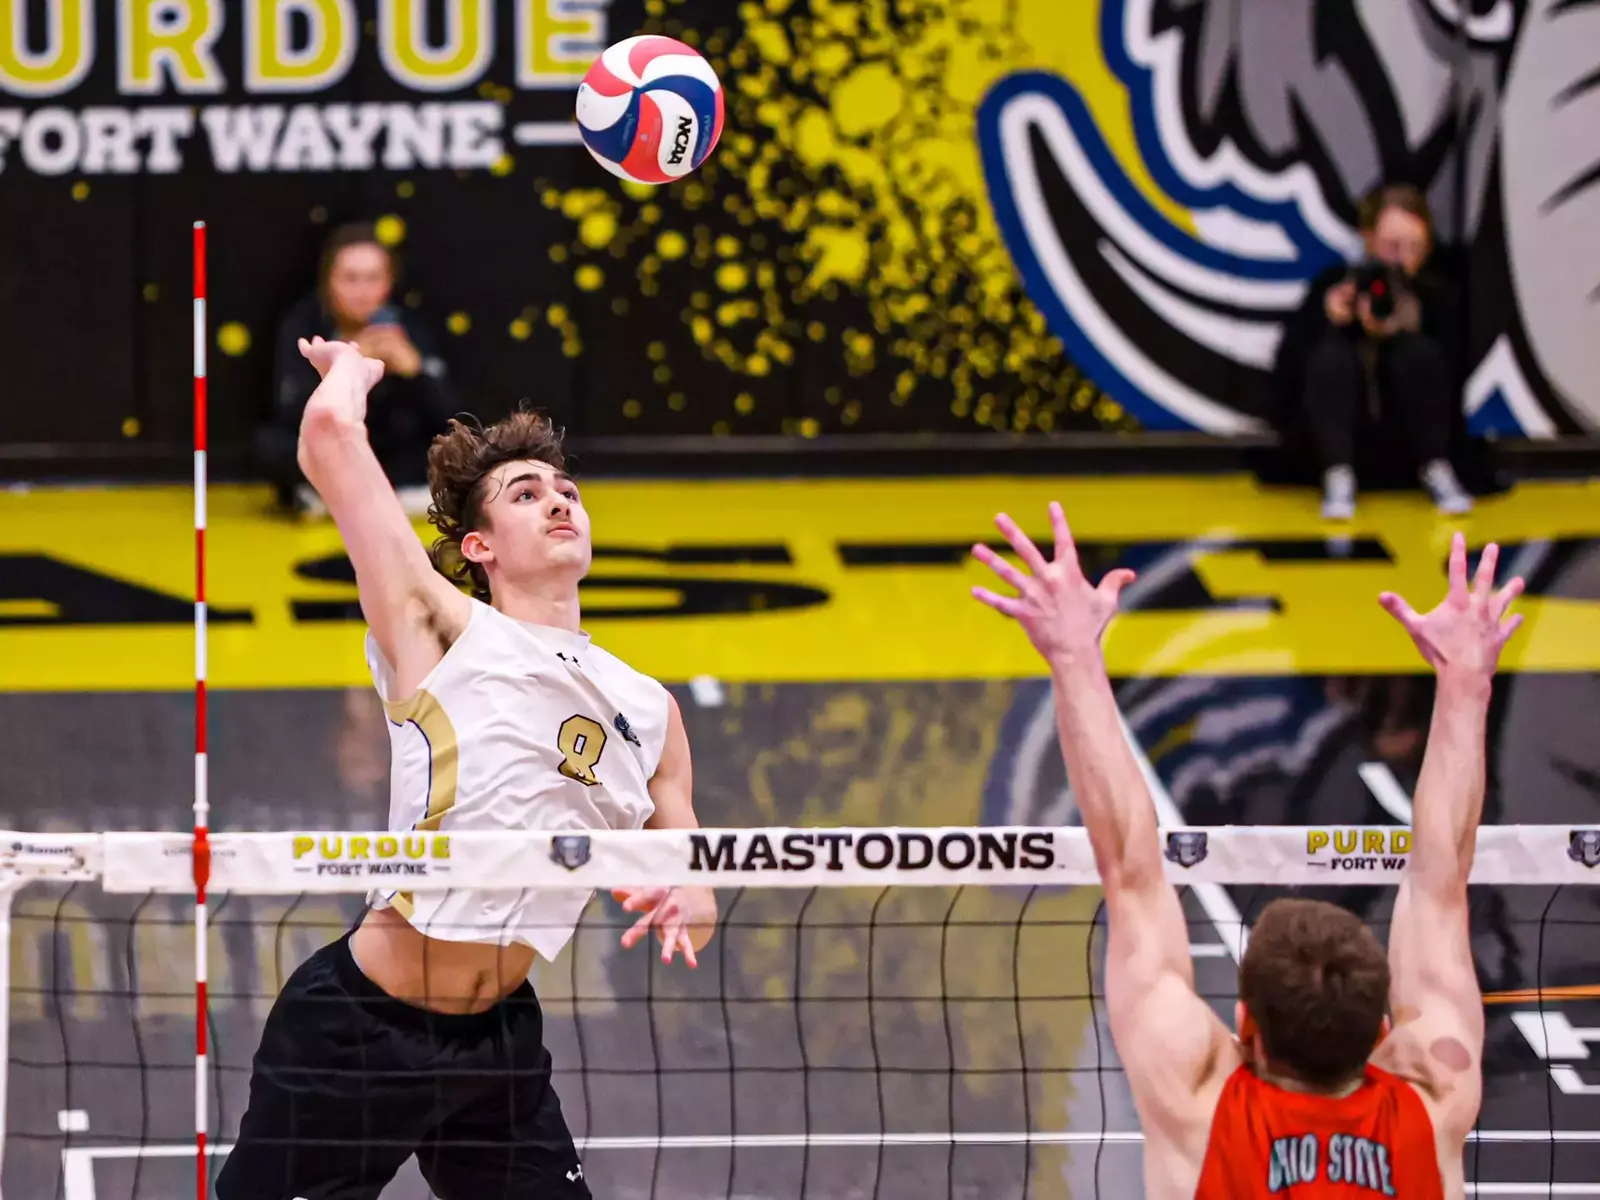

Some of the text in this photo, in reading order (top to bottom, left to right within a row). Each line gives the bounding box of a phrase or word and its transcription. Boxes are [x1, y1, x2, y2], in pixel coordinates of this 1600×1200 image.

[202, 103, 503, 171] WAYNE
[667, 115, 692, 165] NCAA
[292, 835, 451, 860] PURDUE
[690, 831, 1055, 871] MASTODONS
[317, 862, 428, 876] FORT WAYNE
[1331, 857, 1378, 871] FORT
